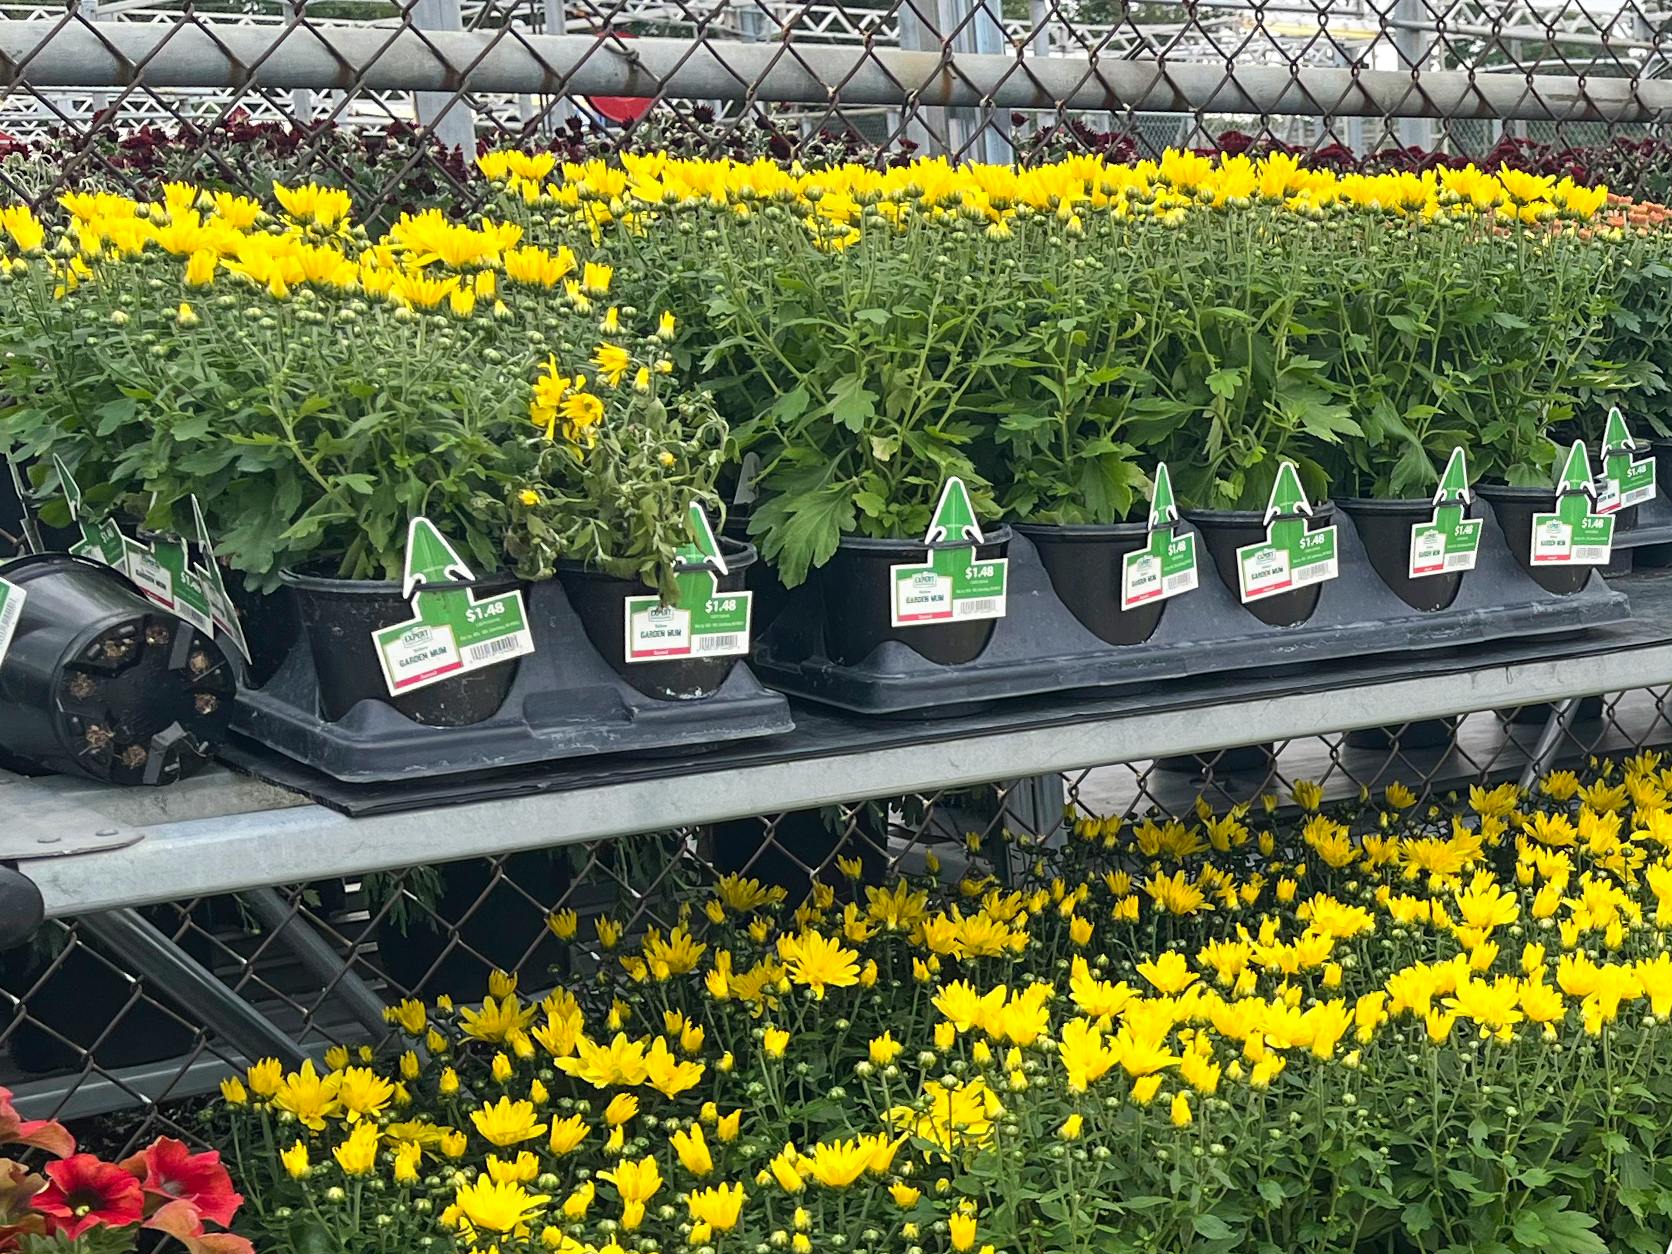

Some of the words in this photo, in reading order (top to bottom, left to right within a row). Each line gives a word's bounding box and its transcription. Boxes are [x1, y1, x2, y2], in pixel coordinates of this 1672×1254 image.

[1627, 465, 1646, 478] $1.48
[1581, 517, 1603, 529] $1.48
[1454, 525, 1474, 536] $1.48
[1168, 540, 1186, 556] $1.48
[1300, 534, 1324, 549] $1.48
[965, 565, 994, 580] $1.48
[466, 602, 505, 622] $1.48
[705, 600, 736, 613] $1.48
[404, 629, 430, 643] EXPERT
[640, 630, 665, 639] GARDEN
[399, 651, 428, 667] GARDEN
[430, 646, 447, 658] MUM
